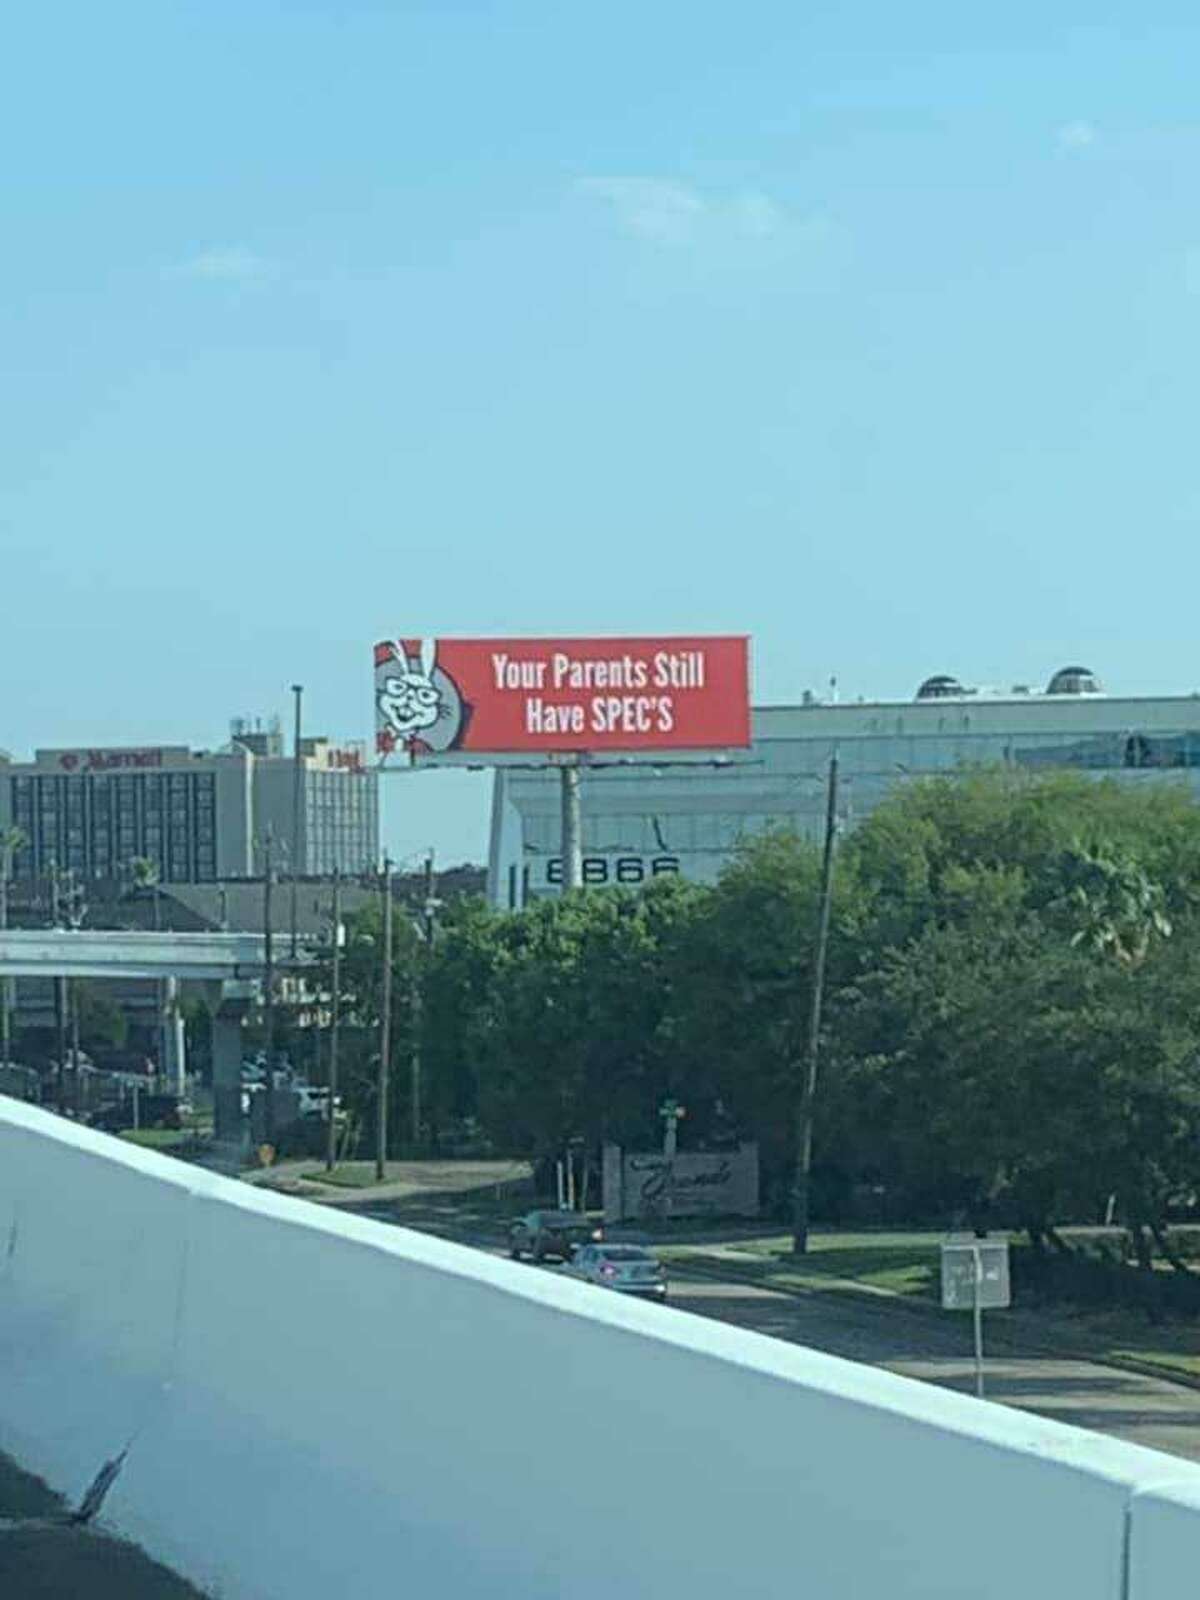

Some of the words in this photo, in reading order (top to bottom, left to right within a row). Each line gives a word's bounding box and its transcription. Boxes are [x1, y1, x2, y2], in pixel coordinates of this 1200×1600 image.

[492, 654, 547, 688] Your
[554, 652, 648, 688] Parents
[653, 651, 704, 687] Still
[526, 699, 584, 733] Have
[591, 697, 673, 732] SPEC'S
